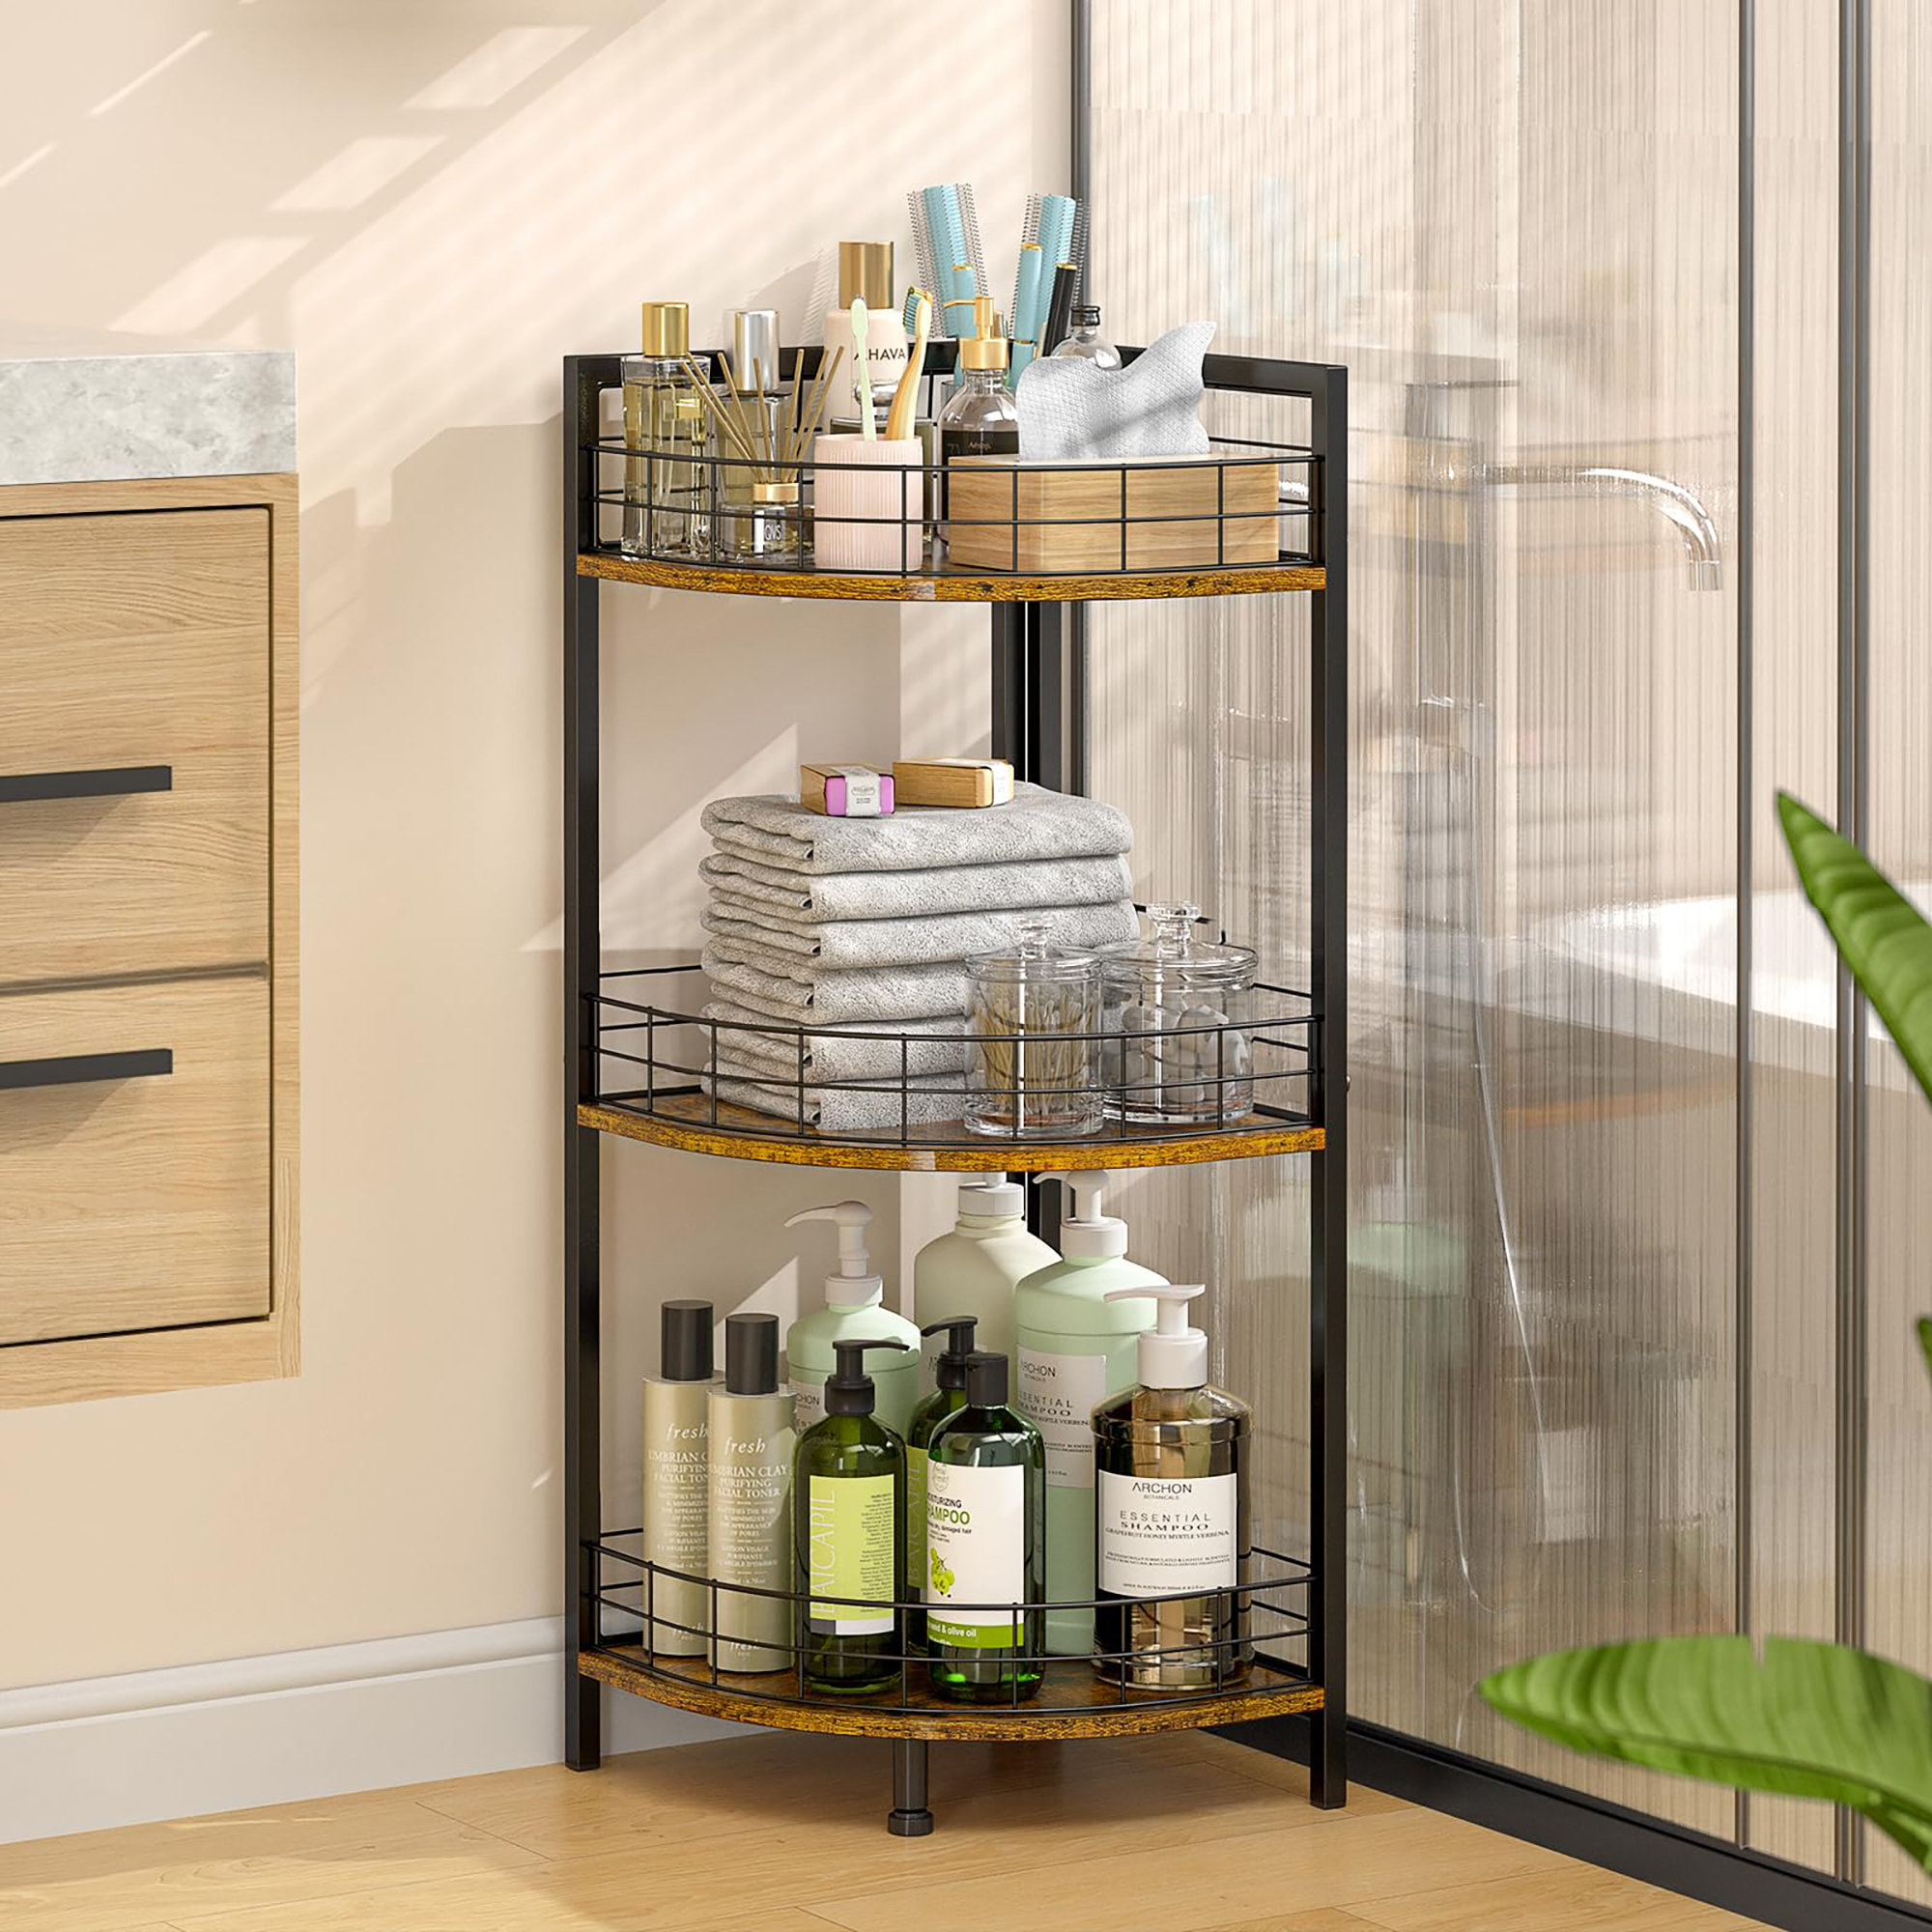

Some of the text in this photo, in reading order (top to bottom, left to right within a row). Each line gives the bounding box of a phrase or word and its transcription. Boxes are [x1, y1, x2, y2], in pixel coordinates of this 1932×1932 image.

[667, 1422, 709, 1442] fresh
[724, 1436, 766, 1456] fresh
[662, 1464, 708, 1473] PURIFYIN
[711, 1463, 787, 1478] MBRIAN CLAY
[1132, 1482, 1192, 1493] ARCHON
[927, 1503, 970, 1525] HAMPOO
[1121, 1510, 1211, 1522] ESSENTIAL
[1121, 1521, 1209, 1531] SHAMPOO
